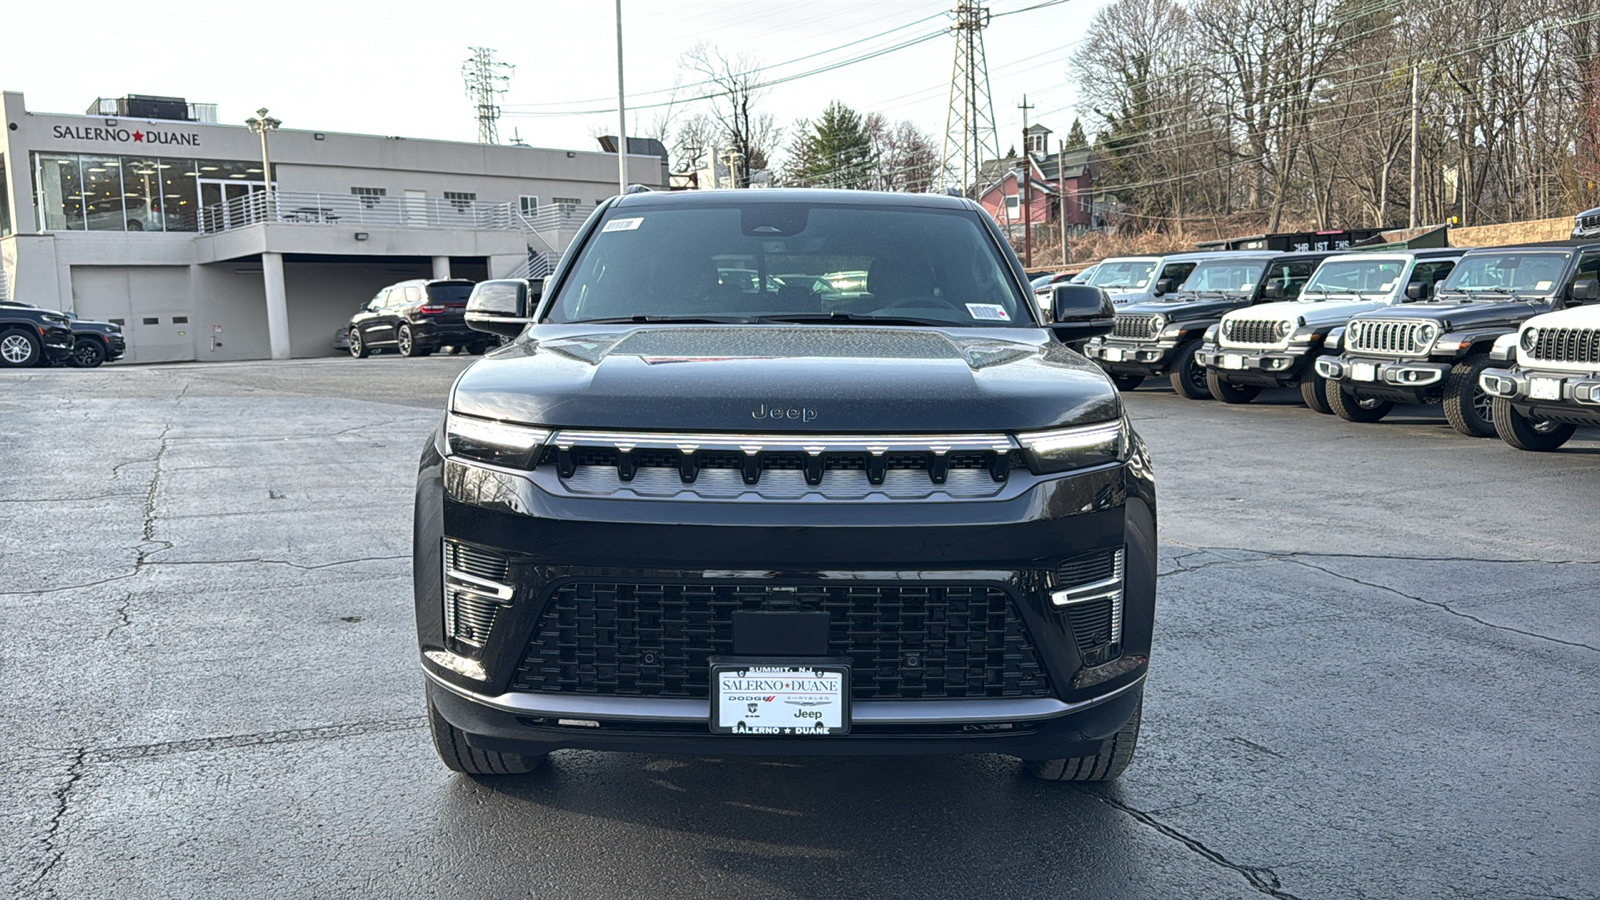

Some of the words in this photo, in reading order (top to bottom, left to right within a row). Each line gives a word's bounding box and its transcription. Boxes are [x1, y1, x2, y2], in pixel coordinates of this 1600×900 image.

[53, 125, 130, 142] SALERNO
[146, 131, 200, 146] DUANE
[752, 404, 818, 422] Jeep
[723, 680, 783, 691] SALERNO
[791, 681, 838, 691] DUANE
[794, 708, 822, 720] Jeep
